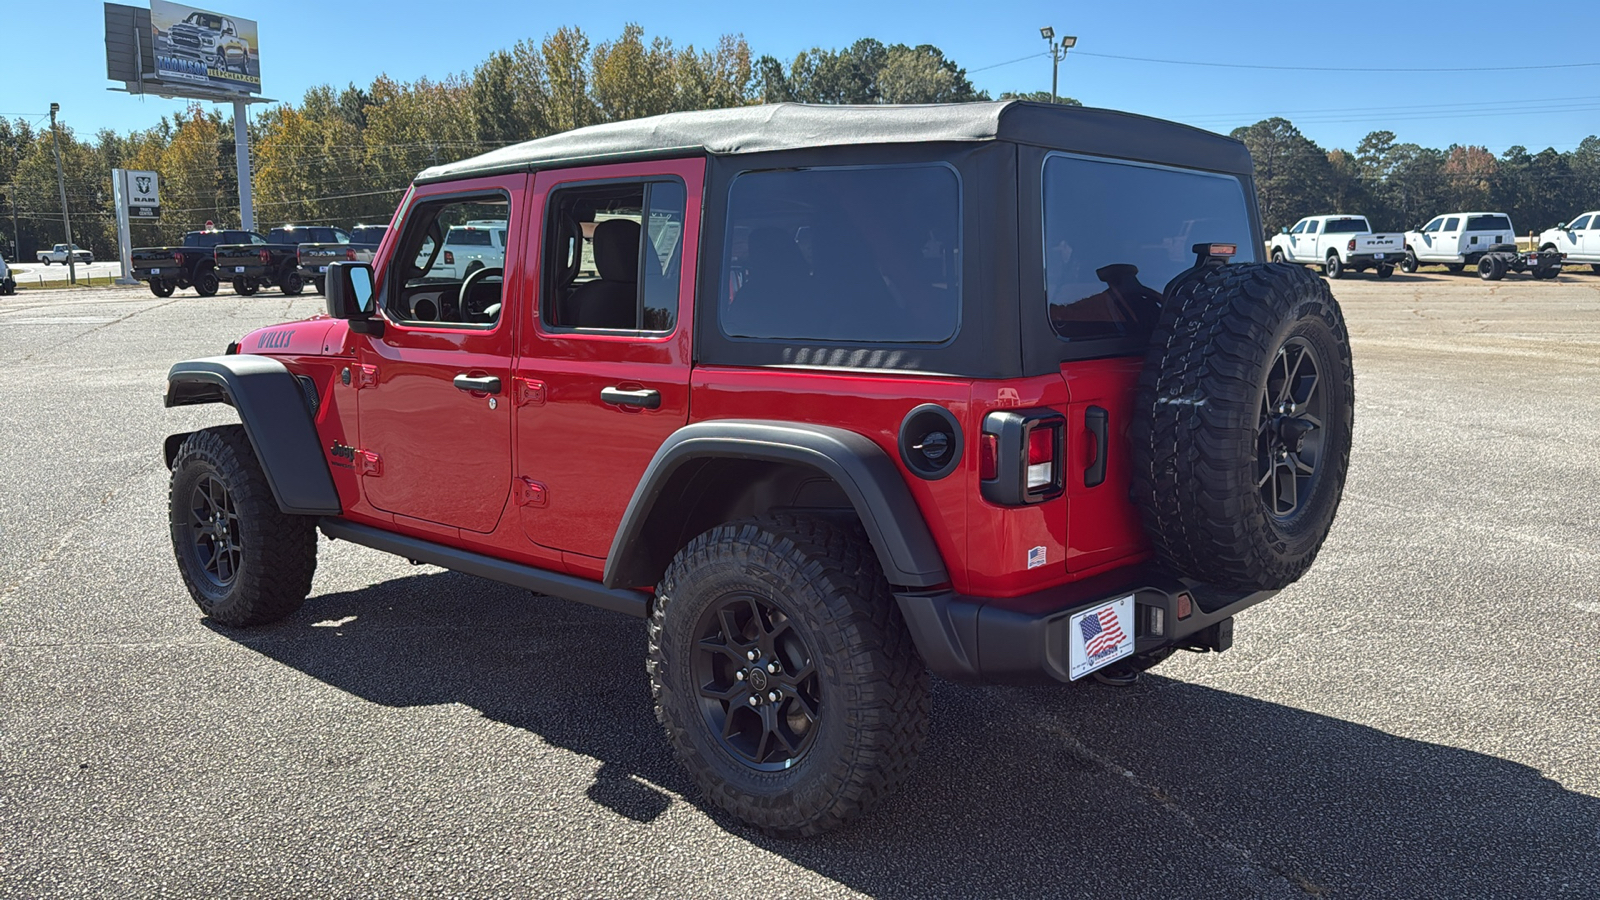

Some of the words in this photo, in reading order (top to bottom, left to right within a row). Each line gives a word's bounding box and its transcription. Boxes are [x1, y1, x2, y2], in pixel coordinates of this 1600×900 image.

[157, 55, 208, 75] THOMSON
[257, 330, 296, 348] WILLYS
[330, 439, 355, 463] Jeep
